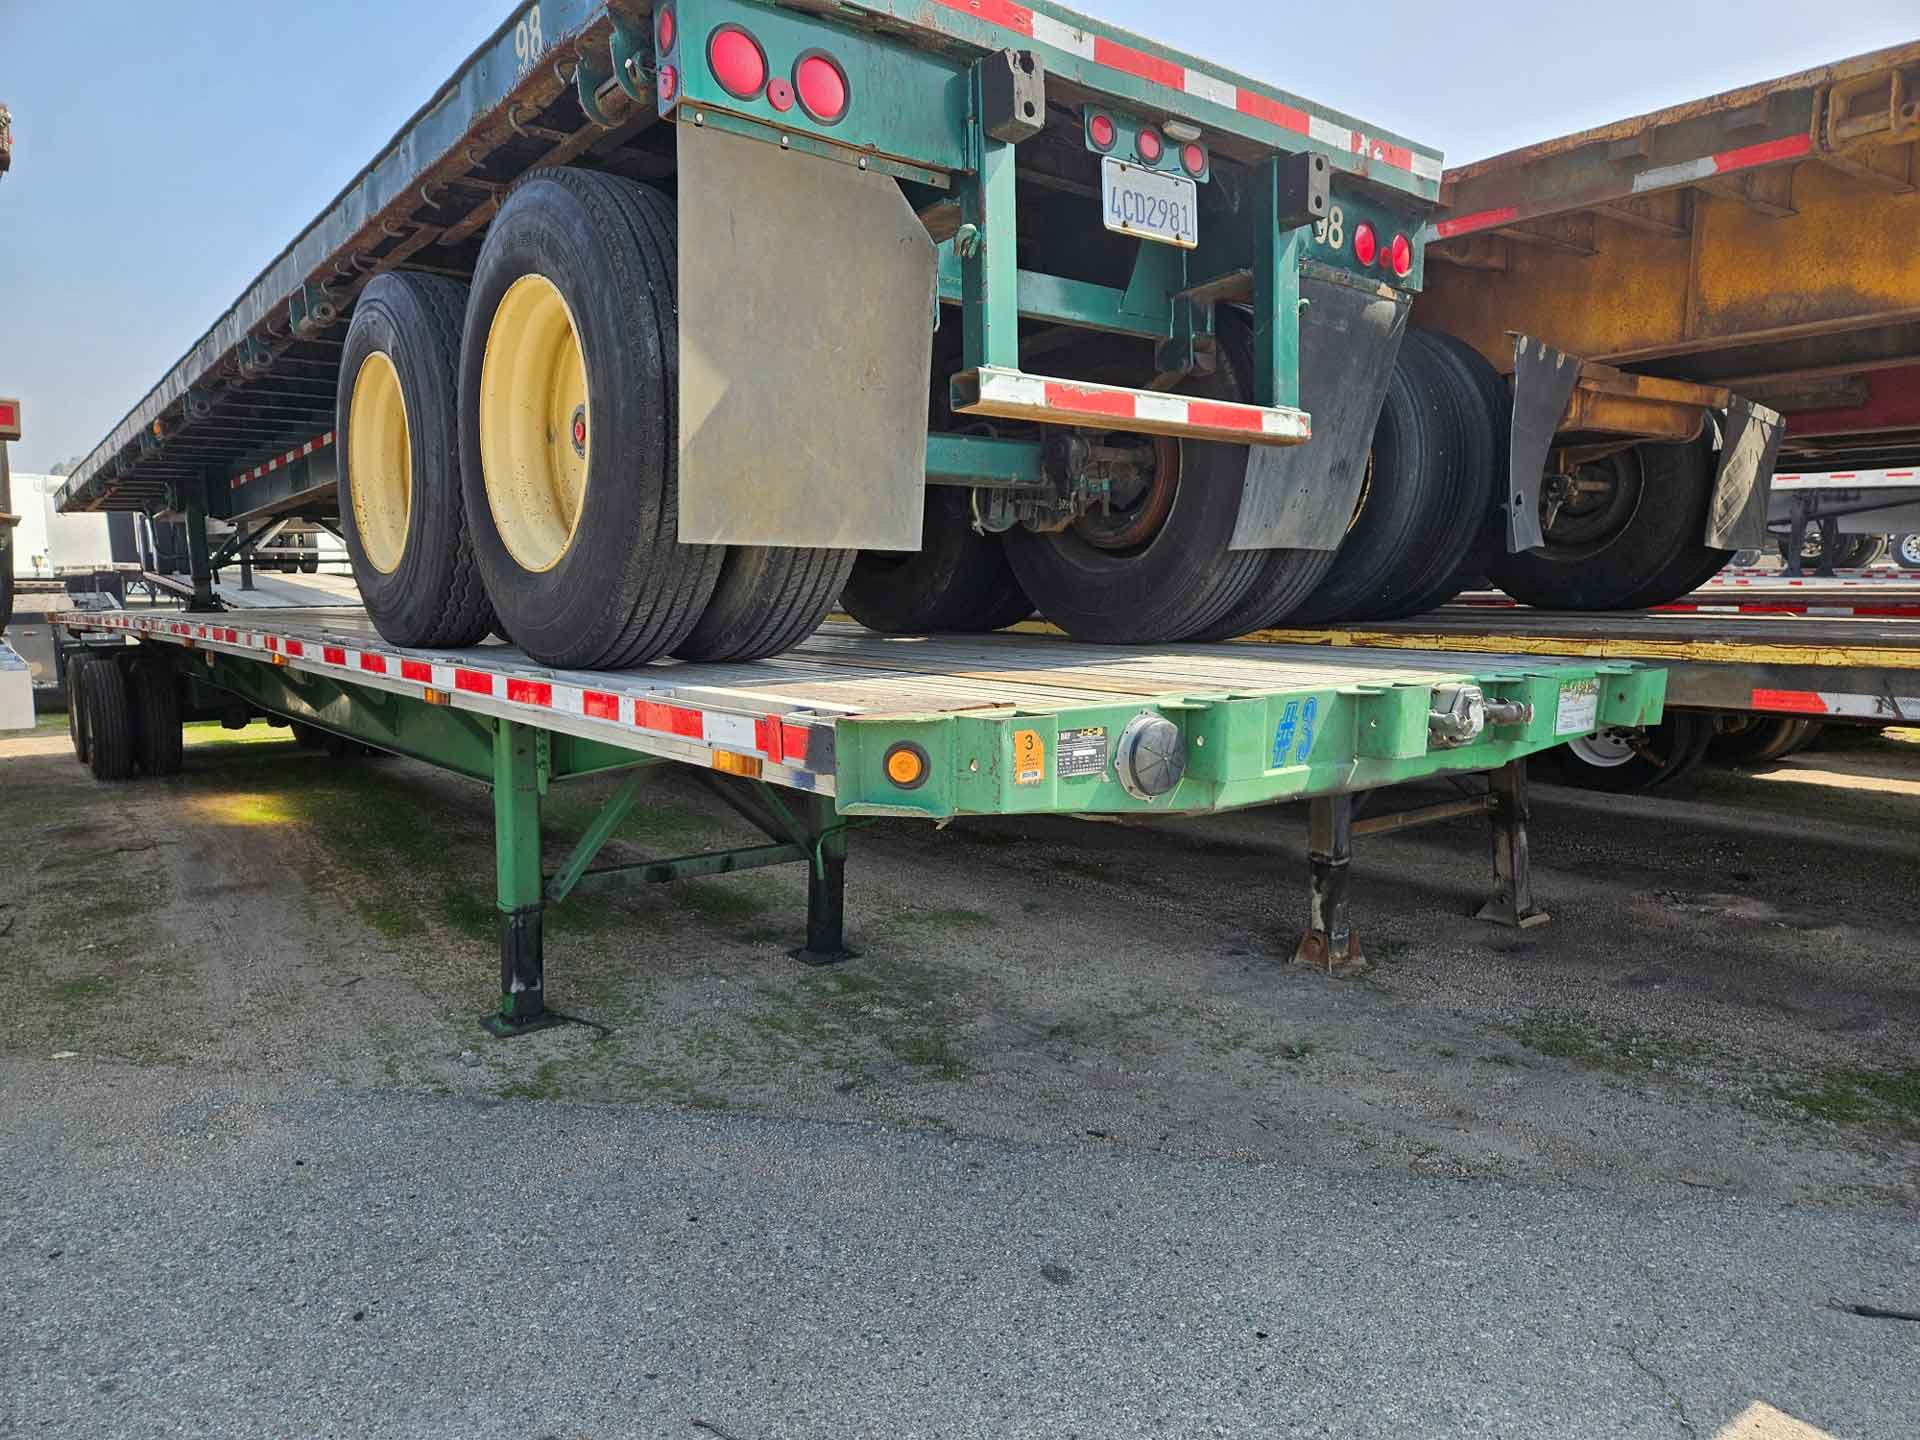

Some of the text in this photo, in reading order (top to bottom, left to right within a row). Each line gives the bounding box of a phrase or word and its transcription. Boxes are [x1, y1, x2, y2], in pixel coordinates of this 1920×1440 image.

[515, 4, 543, 64] 98
[1111, 186, 1191, 236] 4CD2981
[1024, 734, 1034, 750] 3
